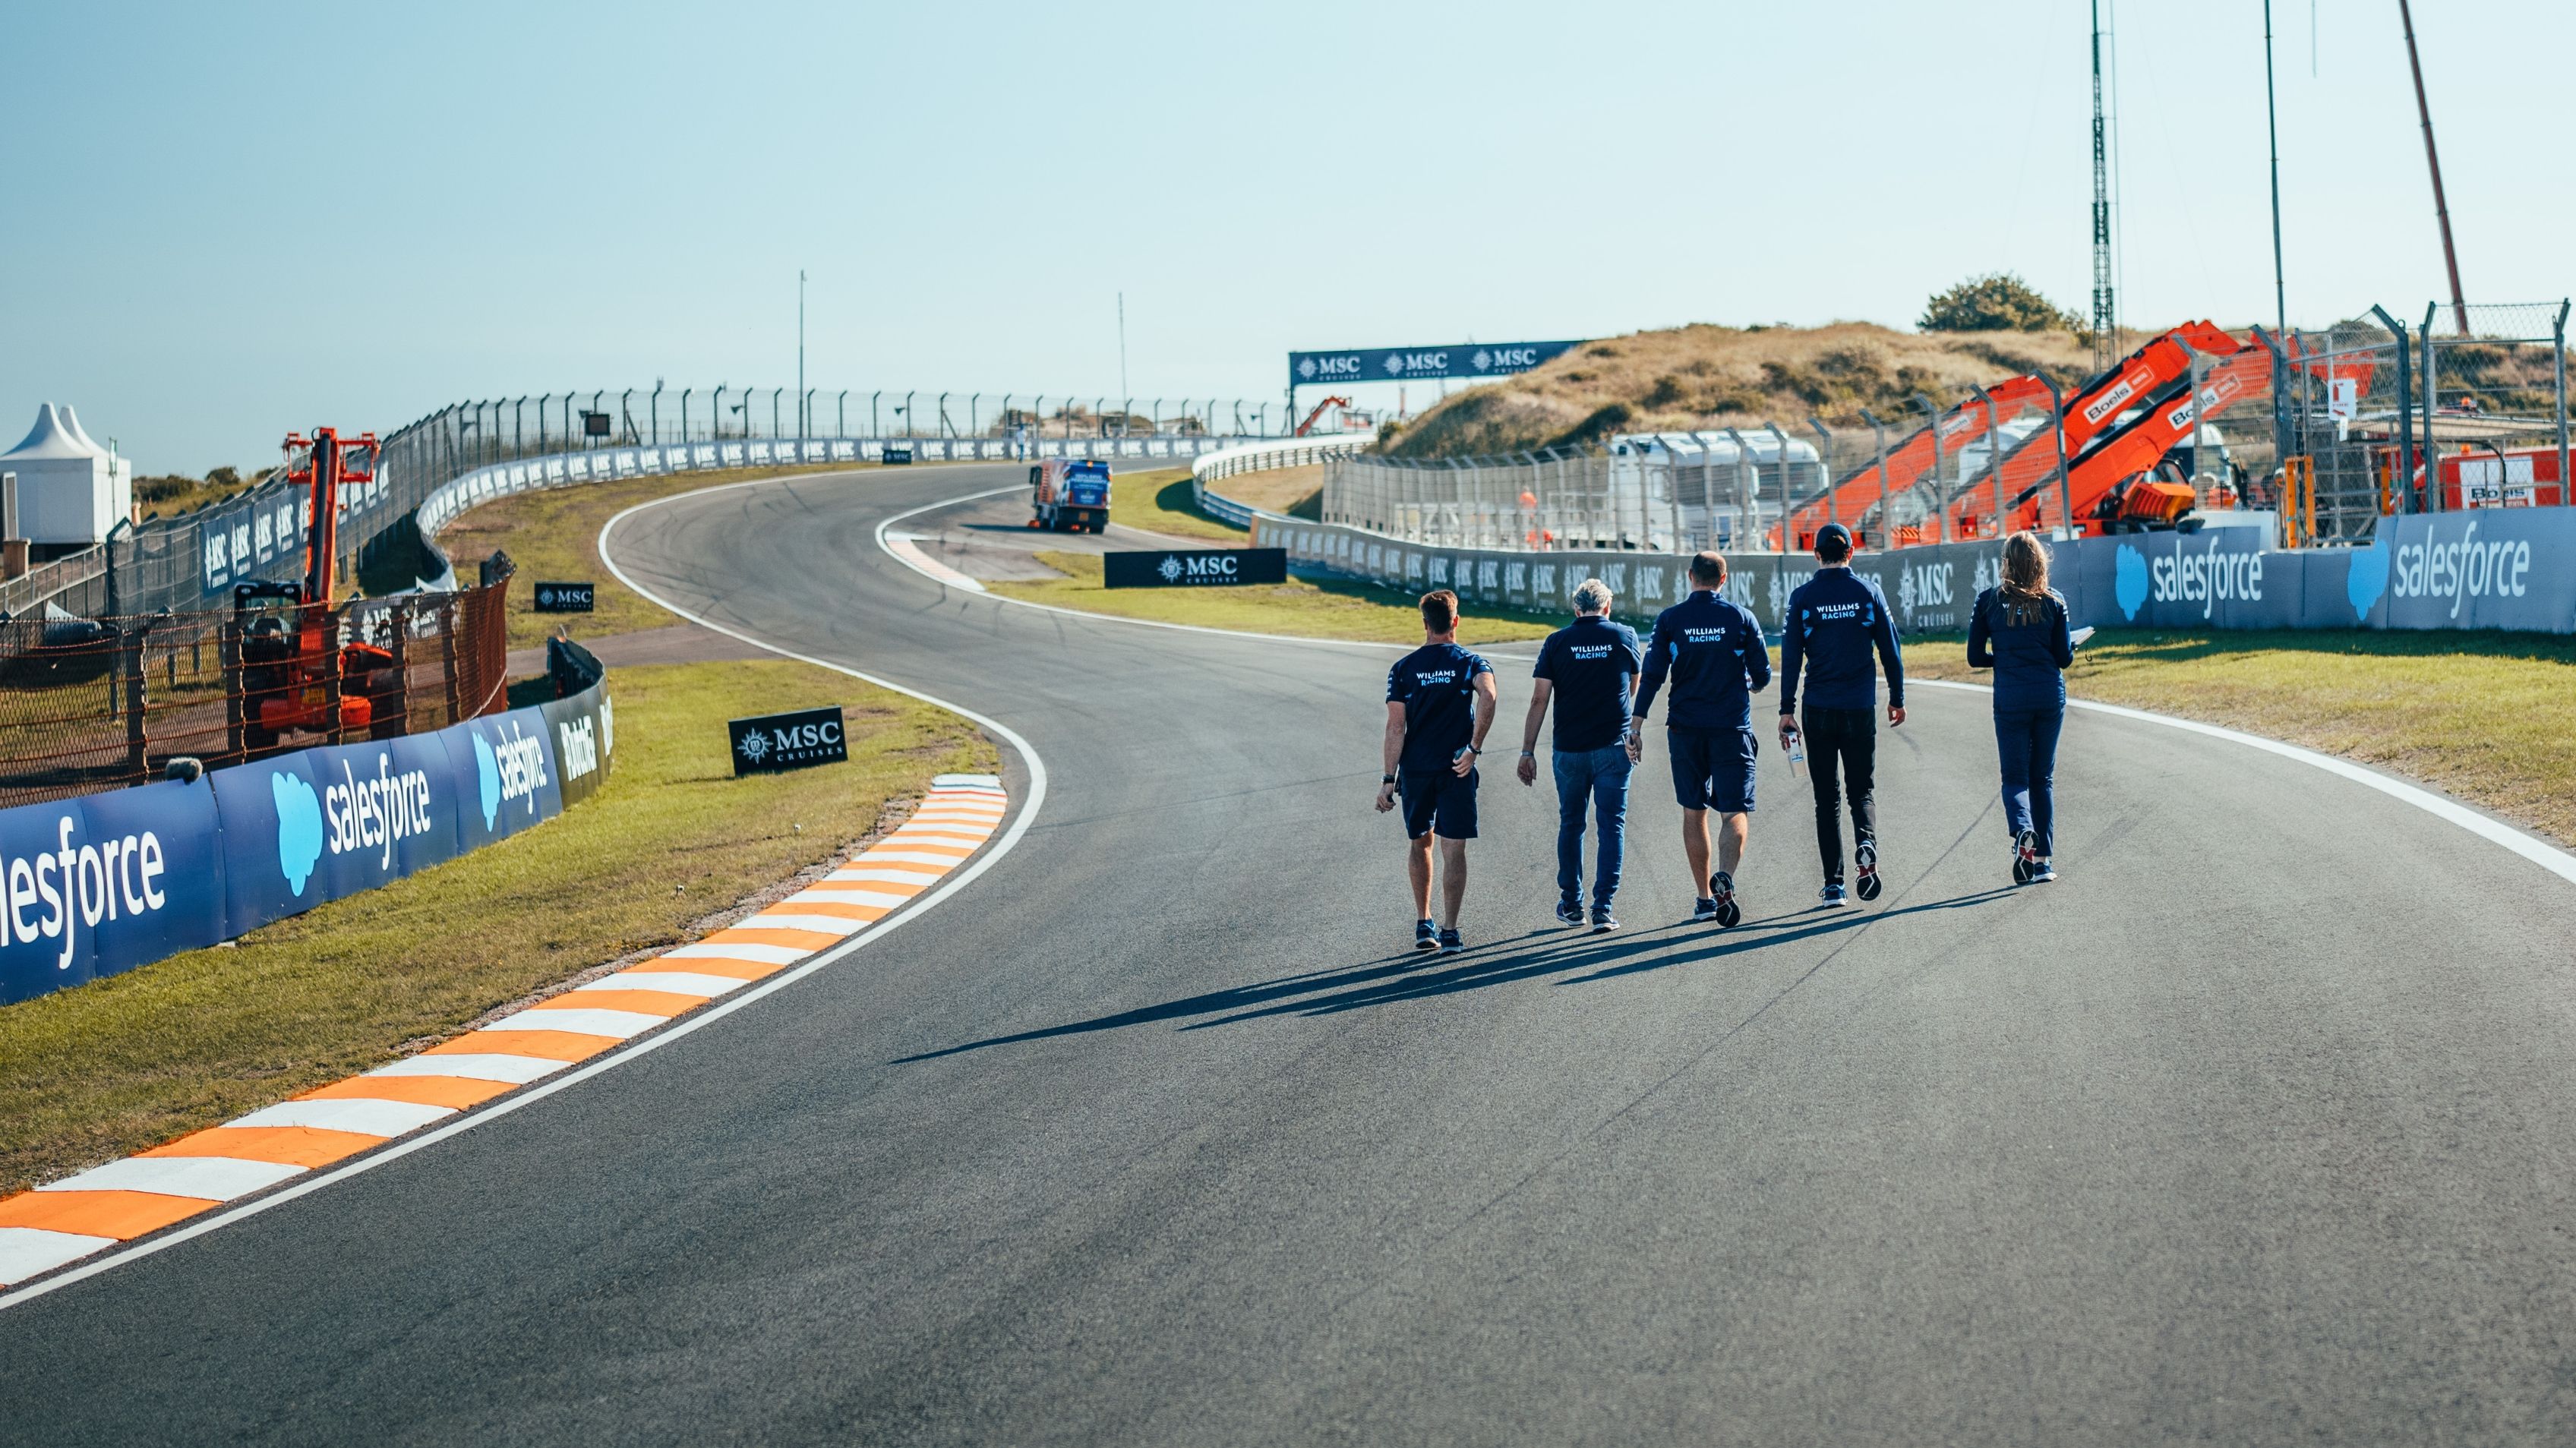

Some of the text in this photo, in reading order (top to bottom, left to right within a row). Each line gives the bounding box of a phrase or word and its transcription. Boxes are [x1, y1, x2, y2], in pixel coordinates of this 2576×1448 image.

[1319, 356, 1360, 374] MSC
[1406, 352, 1448, 371] MSC
[1494, 349, 1536, 366] MSC
[2088, 388, 2129, 419] Boels
[2172, 395, 2215, 425] Bols
[1186, 556, 1237, 576] MSC
[2394, 521, 2530, 619] salesforce
[1916, 563, 1953, 606] MSC
[2153, 535, 2262, 619] salesforce
[557, 590, 592, 603] MSC
[1731, 571, 1755, 607] MSC
[1817, 603, 1860, 613] WILLIAMS
[1823, 610, 1856, 620] RACING
[1918, 613, 1954, 627] CRUISES
[1684, 627, 1726, 636] WILLIAMS
[1571, 644, 1612, 653] WILLIAMS
[1416, 670, 1456, 680] WILLIAMS
[1421, 677, 1451, 686] RACING
[773, 721, 841, 751] MSC
[777, 746, 843, 762] CRUISES
[495, 720, 548, 815] salesforce
[326, 752, 431, 871] salesforce
[0, 815, 166, 970] lesforce
